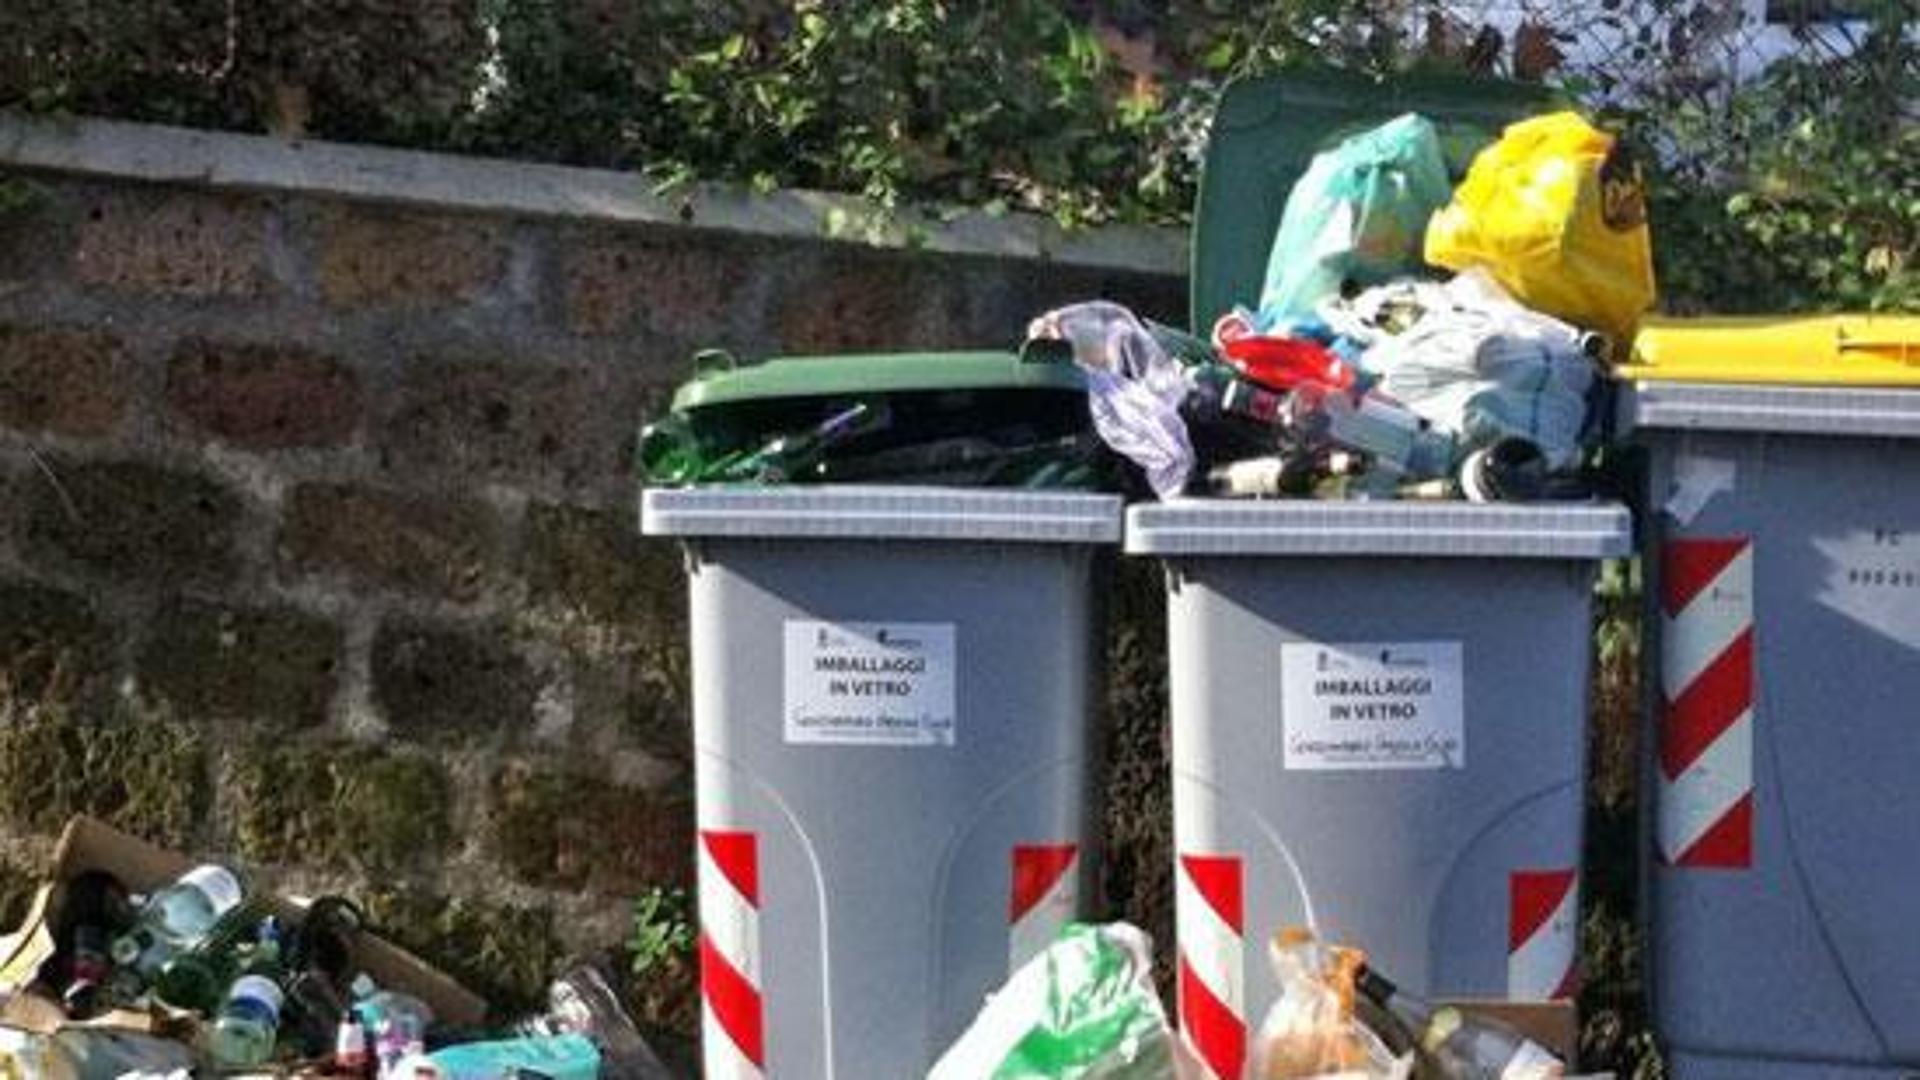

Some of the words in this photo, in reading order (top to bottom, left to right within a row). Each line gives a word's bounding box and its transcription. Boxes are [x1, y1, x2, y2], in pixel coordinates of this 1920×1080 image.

[815, 657, 926, 673] IMBALLAGGI
[830, 680, 848, 696] IN
[851, 680, 911, 696] VETRO
[1315, 677, 1432, 696] IMBALLAGGI
[1330, 704, 1350, 721] IN
[1354, 702, 1416, 721] VETRO
